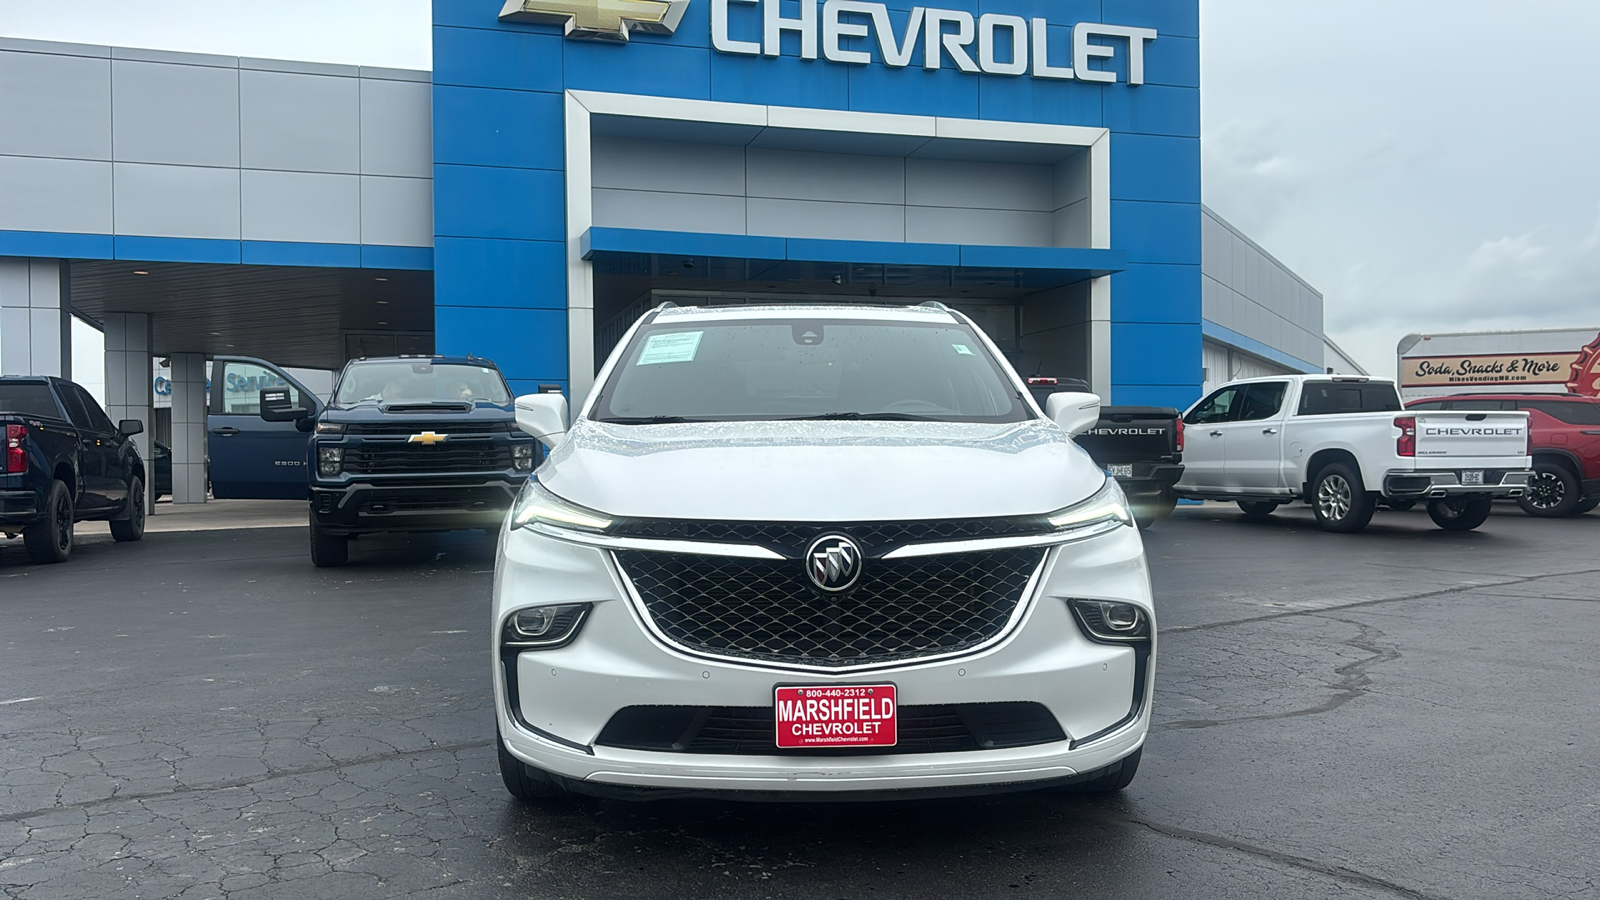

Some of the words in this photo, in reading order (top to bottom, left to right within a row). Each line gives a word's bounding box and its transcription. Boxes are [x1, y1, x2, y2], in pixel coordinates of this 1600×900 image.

[711, 0, 1158, 85] CHEVROLET
[1415, 360, 1455, 377] Soda,
[1456, 359, 1504, 375] Snacks
[1506, 359, 1519, 373] &
[1521, 358, 1560, 376] More
[226, 371, 288, 392] Service
[805, 688, 866, 697] 800-440-2312
[778, 697, 894, 722] MARSHFIELD
[791, 721, 882, 736] CHEVROLET
